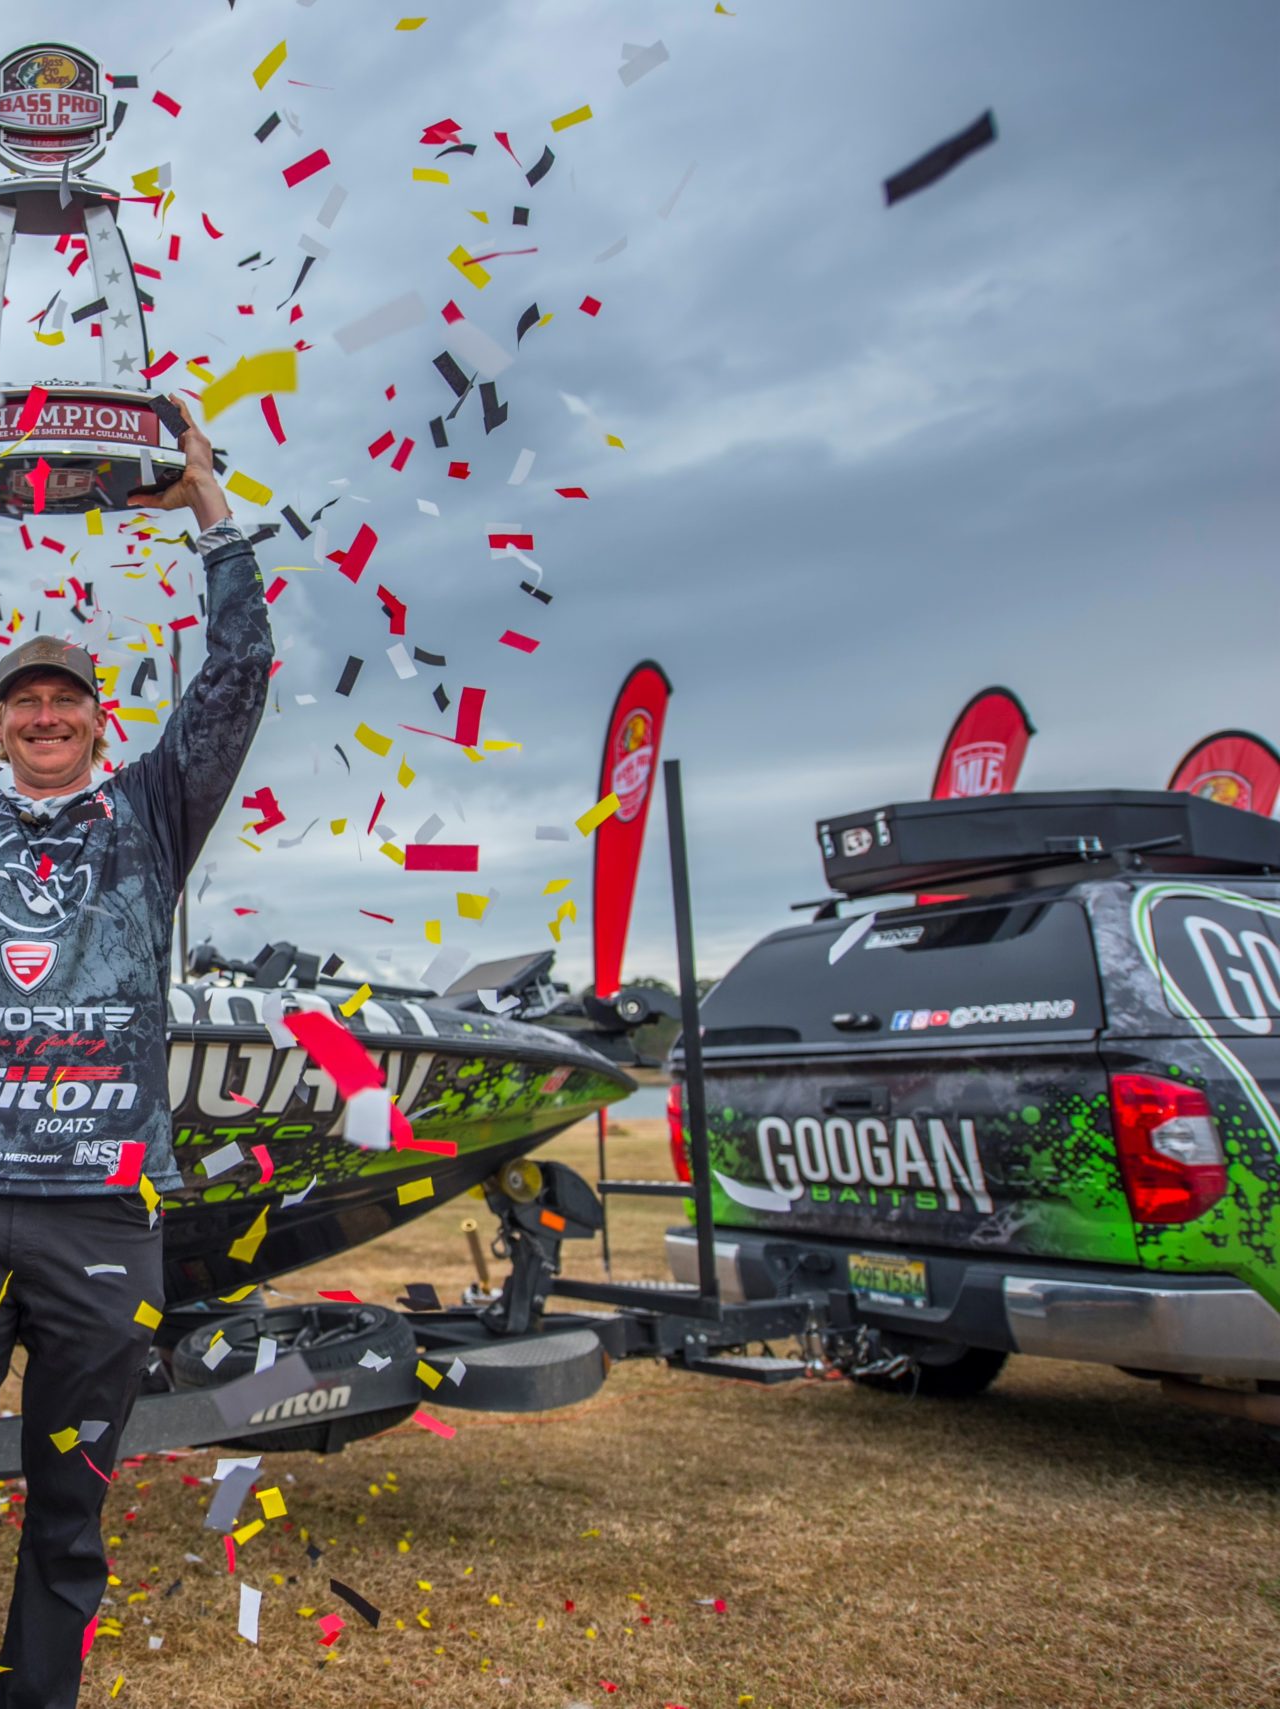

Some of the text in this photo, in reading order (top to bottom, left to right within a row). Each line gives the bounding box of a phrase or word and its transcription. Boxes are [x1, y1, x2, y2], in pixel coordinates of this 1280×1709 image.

[0, 93, 98, 113] BASS PRO
[27, 114, 70, 125] TOUR
[96, 430, 136, 441] CULLMAN,
[34, 1032, 107, 1056] fishing
[35, 1118, 96, 1134] BOATS
[4, 1153, 62, 1163] MERCURY
[757, 1116, 994, 1214] GOOGAN
[811, 1184, 939, 1210] BAITS
